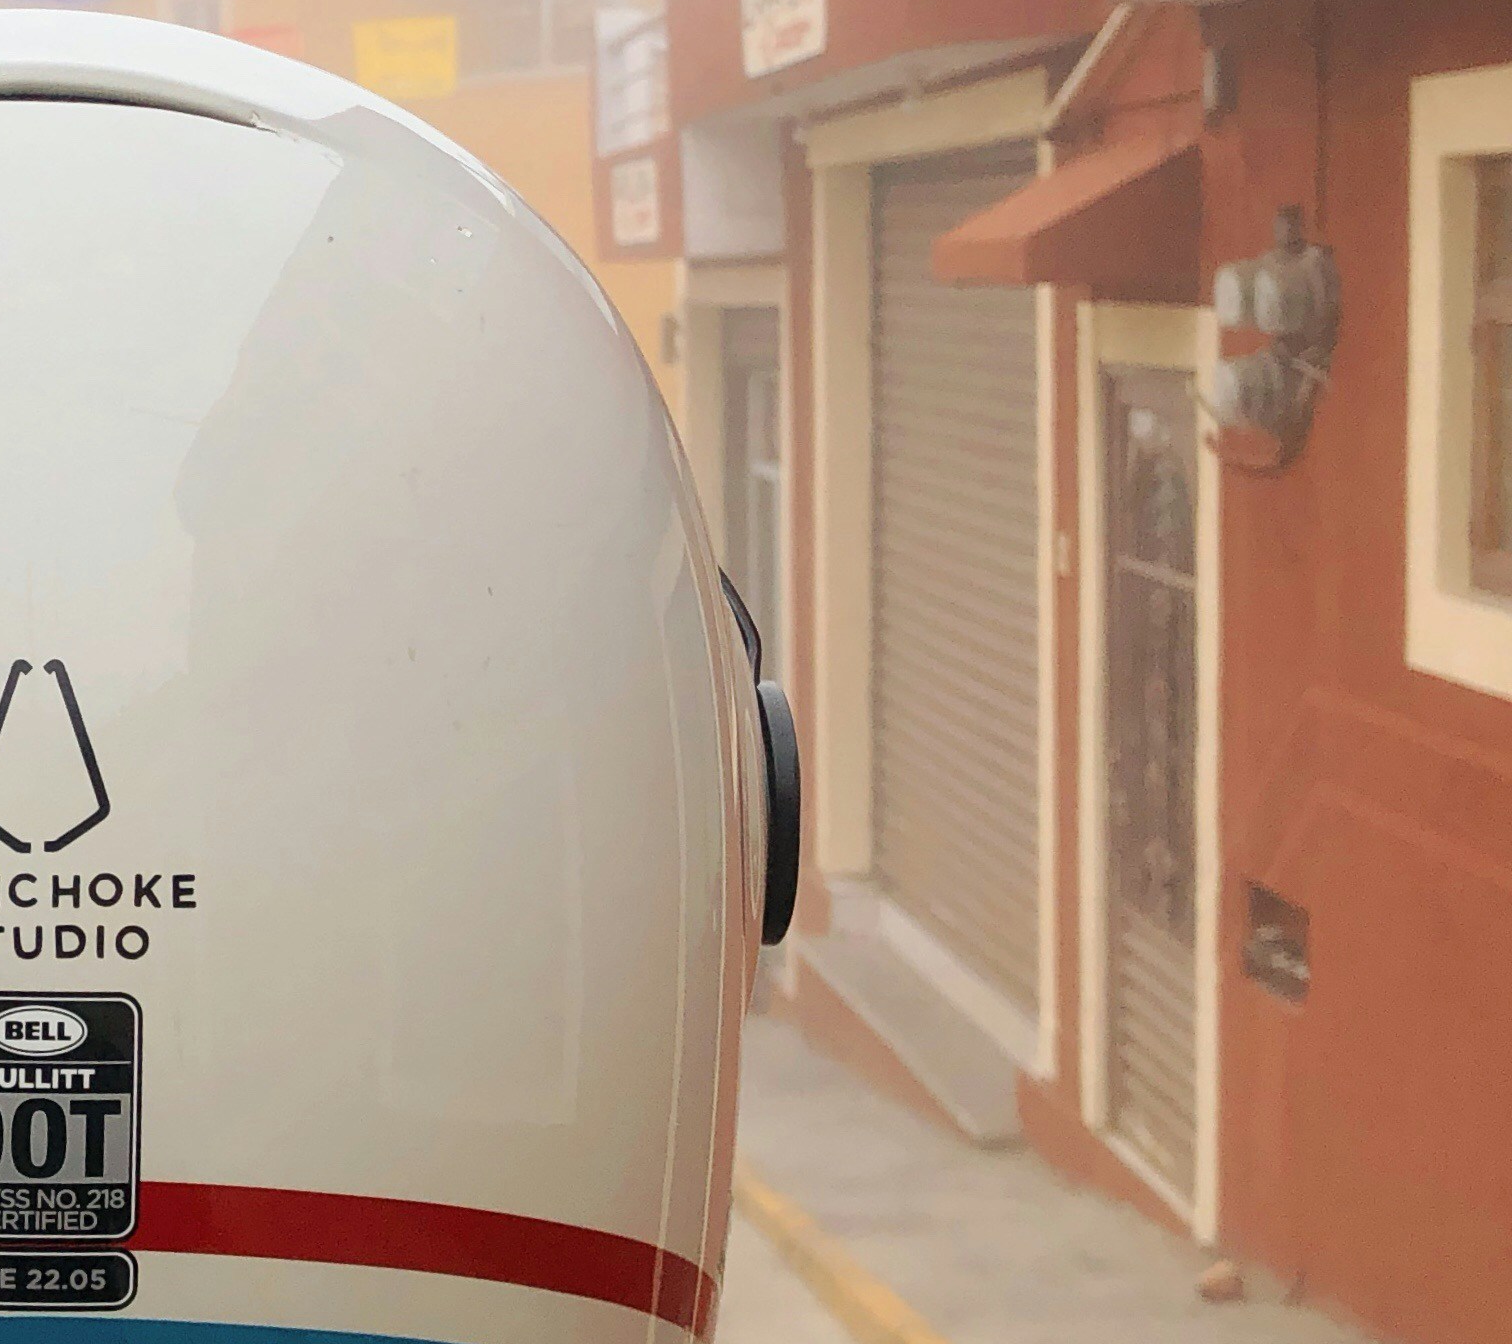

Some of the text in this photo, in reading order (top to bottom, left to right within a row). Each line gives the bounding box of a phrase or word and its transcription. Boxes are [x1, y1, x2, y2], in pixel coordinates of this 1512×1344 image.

[4, 1020, 72, 1042] BELL
[37, 1188, 81, 1209] NO.
[86, 1188, 126, 1210] 218
[25, 1268, 107, 1291] 22.05
